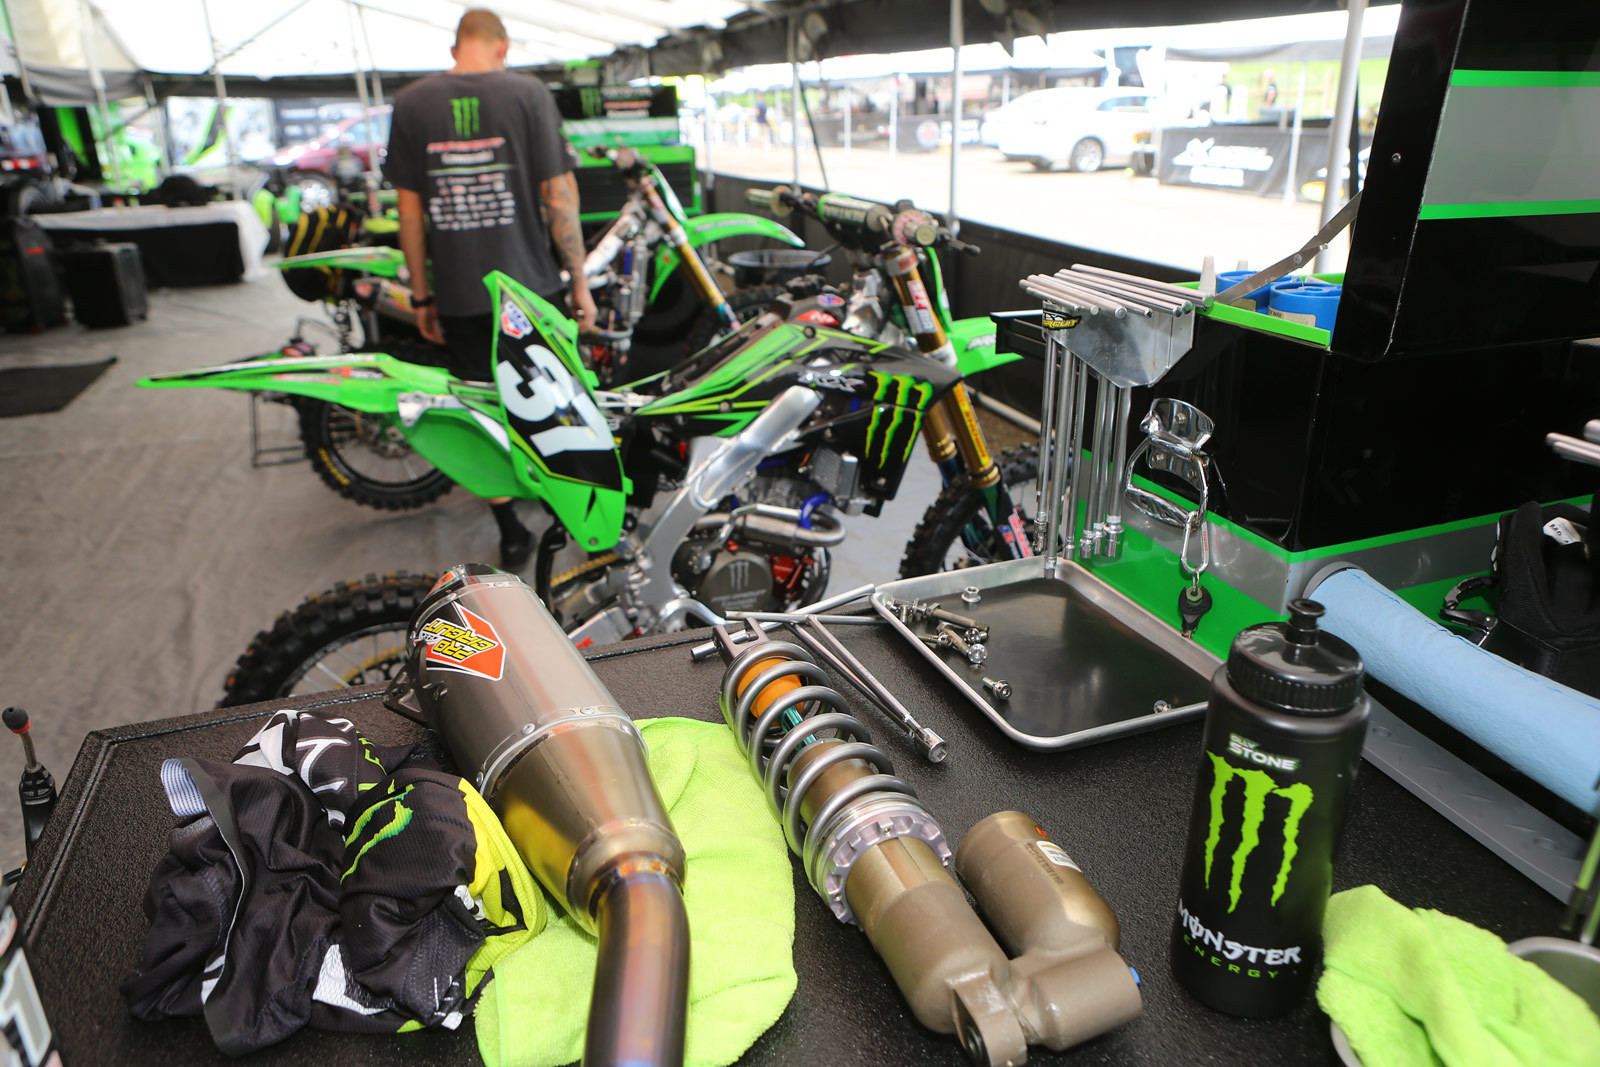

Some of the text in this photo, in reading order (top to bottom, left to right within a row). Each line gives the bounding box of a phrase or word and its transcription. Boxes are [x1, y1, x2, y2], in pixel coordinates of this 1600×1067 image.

[496, 344, 615, 457] 37
[423, 620, 497, 652] CIRCUIT
[431, 639, 478, 661] PRO
[1229, 741, 1297, 771] STONE
[1178, 898, 1302, 966] MONSTER
[1183, 934, 1279, 978] ENERGY
